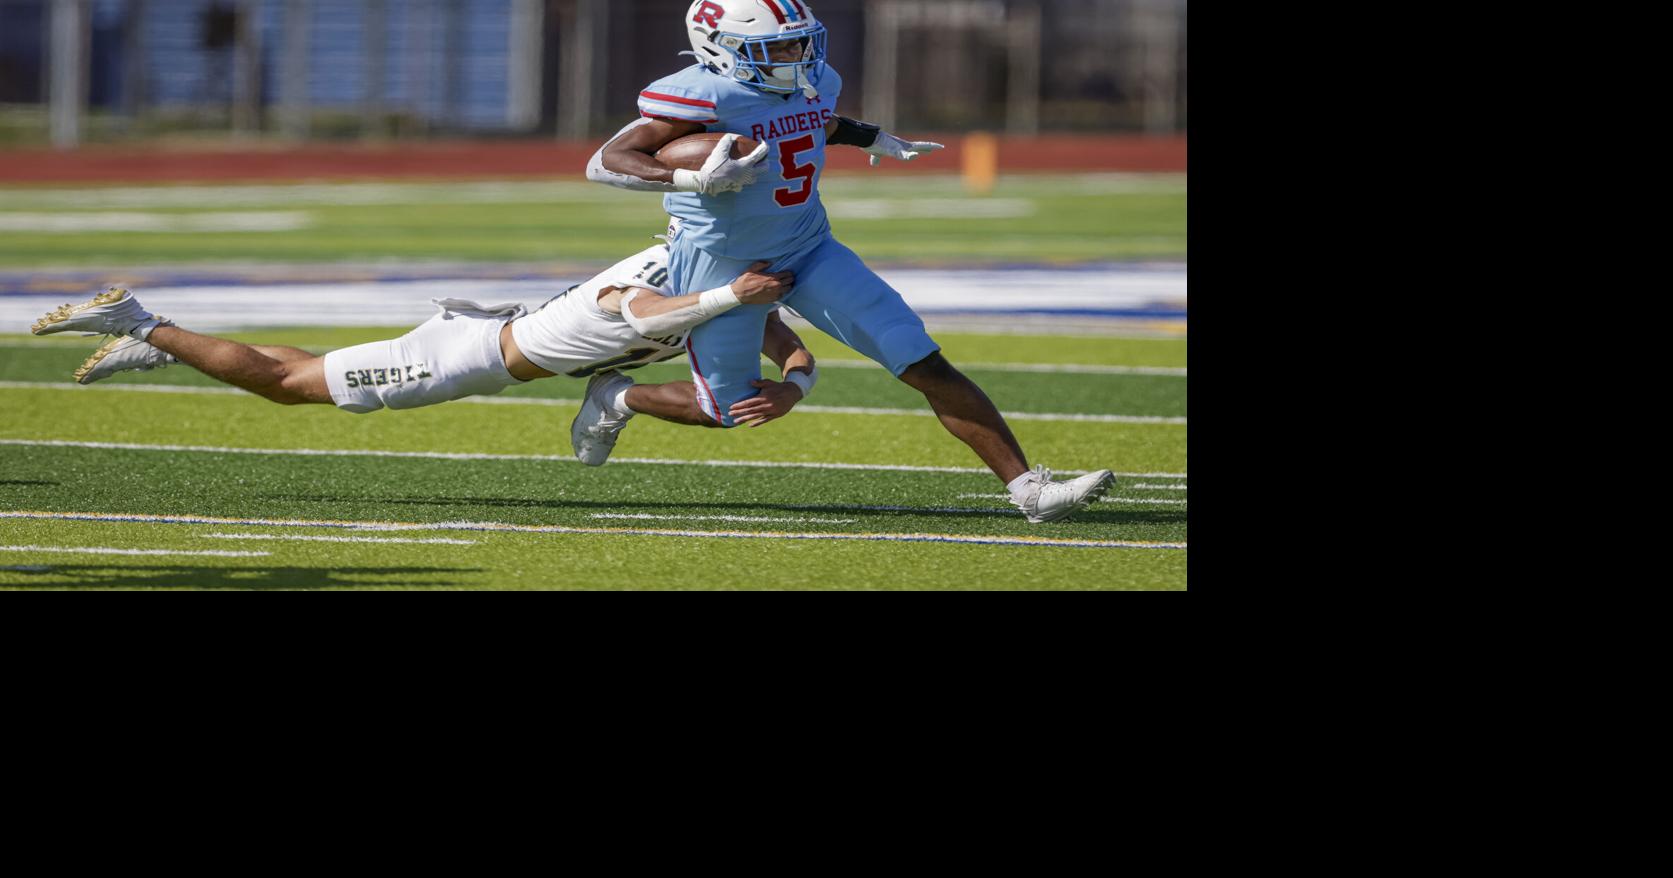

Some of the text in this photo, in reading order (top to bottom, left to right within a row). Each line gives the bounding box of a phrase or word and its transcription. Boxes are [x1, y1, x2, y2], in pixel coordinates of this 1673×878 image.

[693, 1, 724, 29] R
[752, 109, 831, 140] RAIDERS
[774, 134, 816, 207] 5
[345, 365, 432, 388] TIGERS
